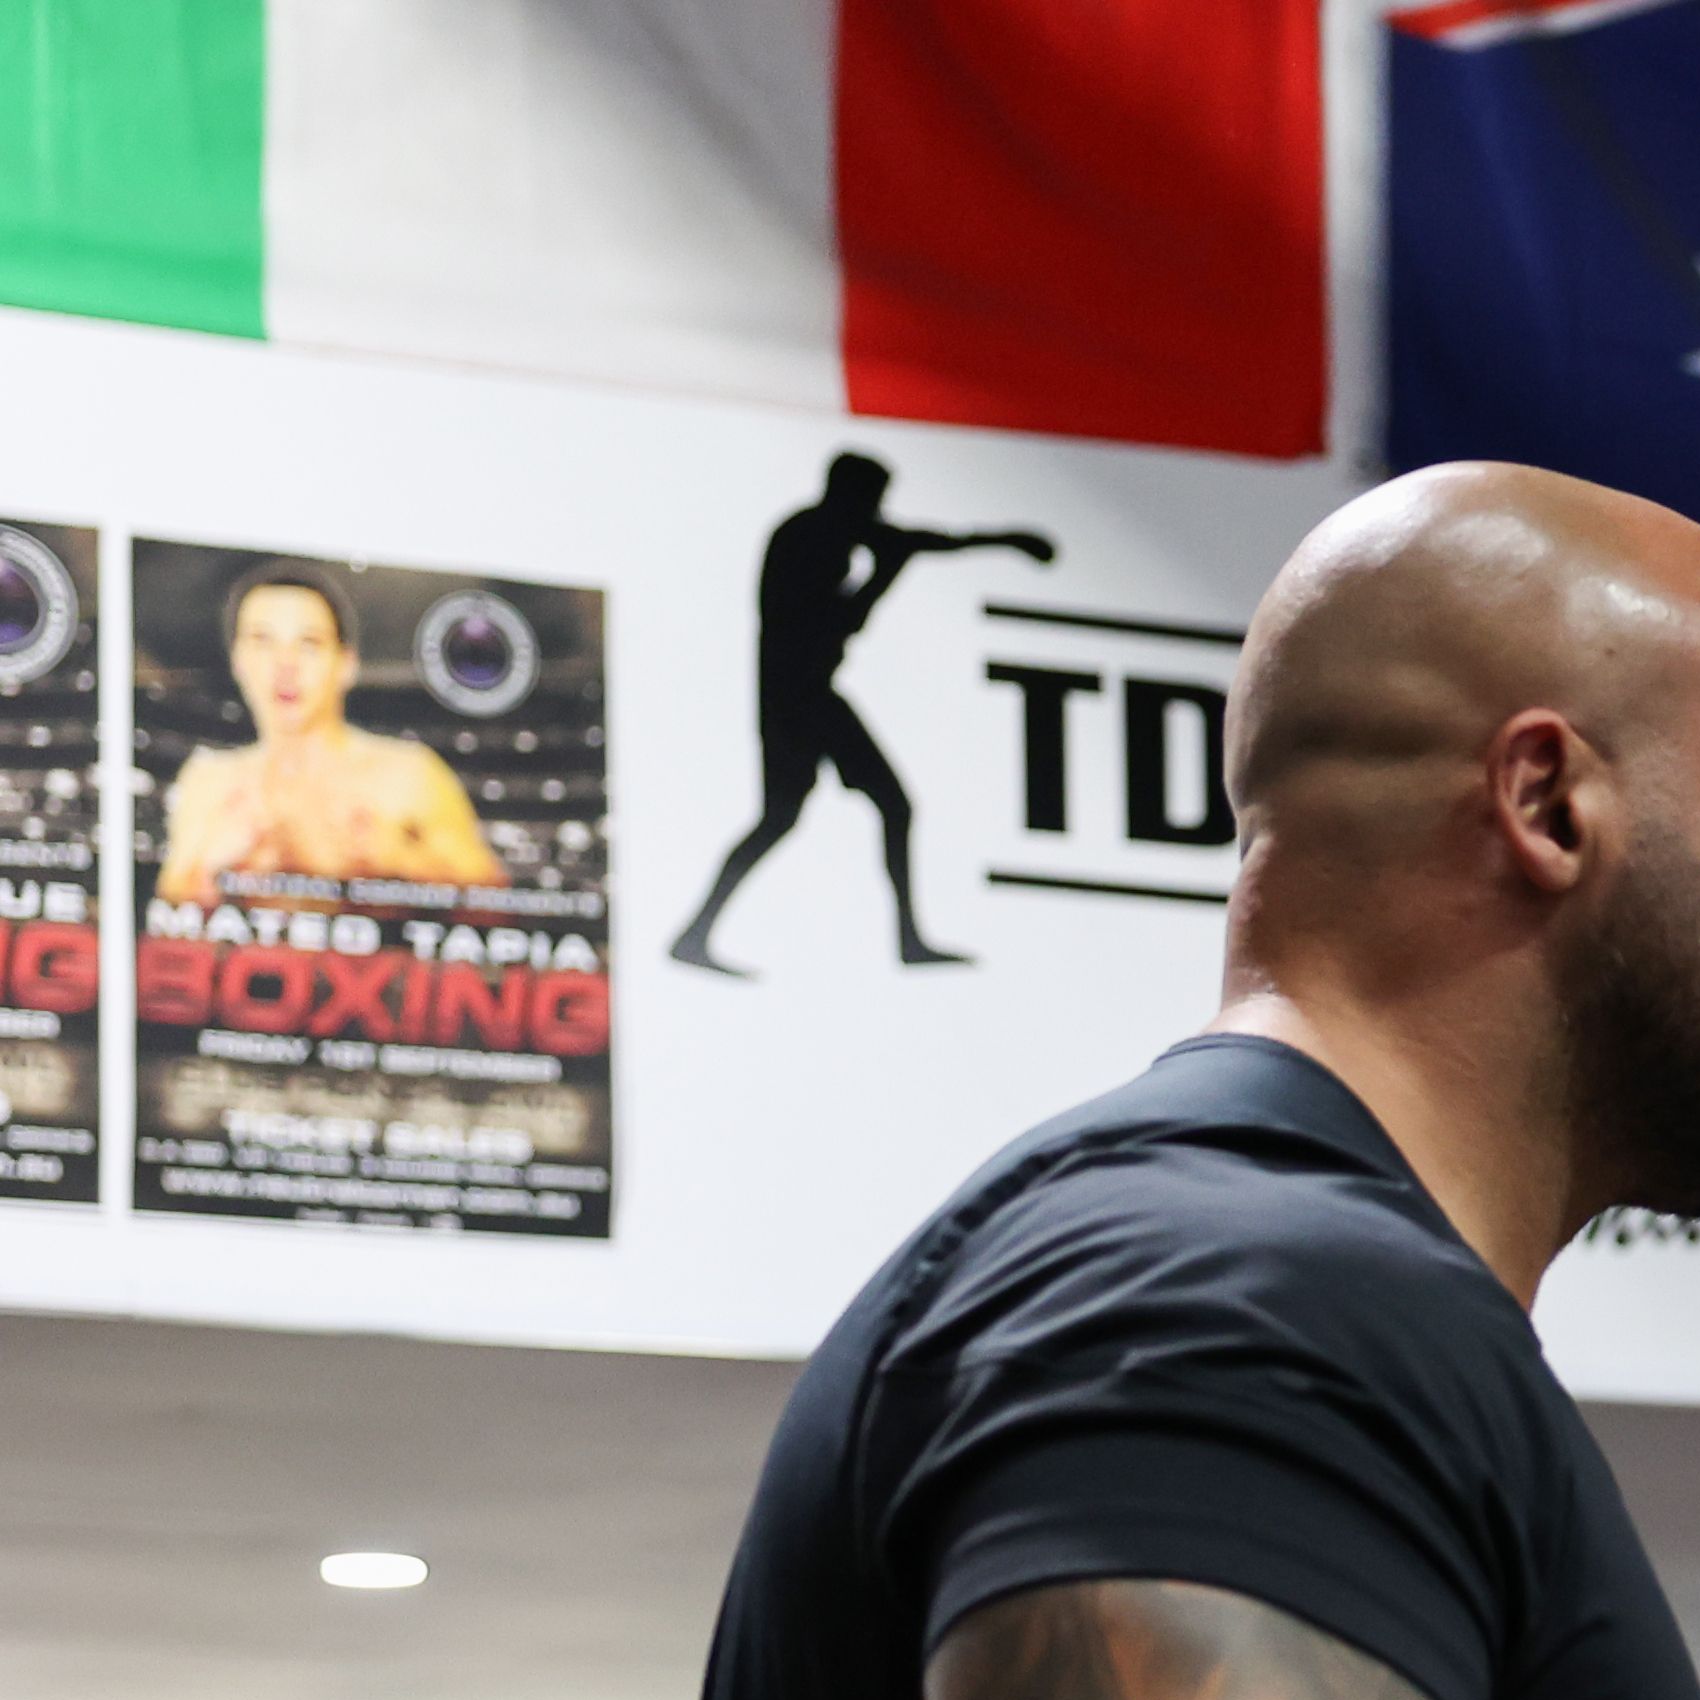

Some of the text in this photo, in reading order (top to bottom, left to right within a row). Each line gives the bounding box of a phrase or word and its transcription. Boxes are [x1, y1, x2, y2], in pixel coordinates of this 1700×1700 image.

[146, 899, 600, 974] MATEO TAPIA
[136, 938, 610, 1056] BOXING
